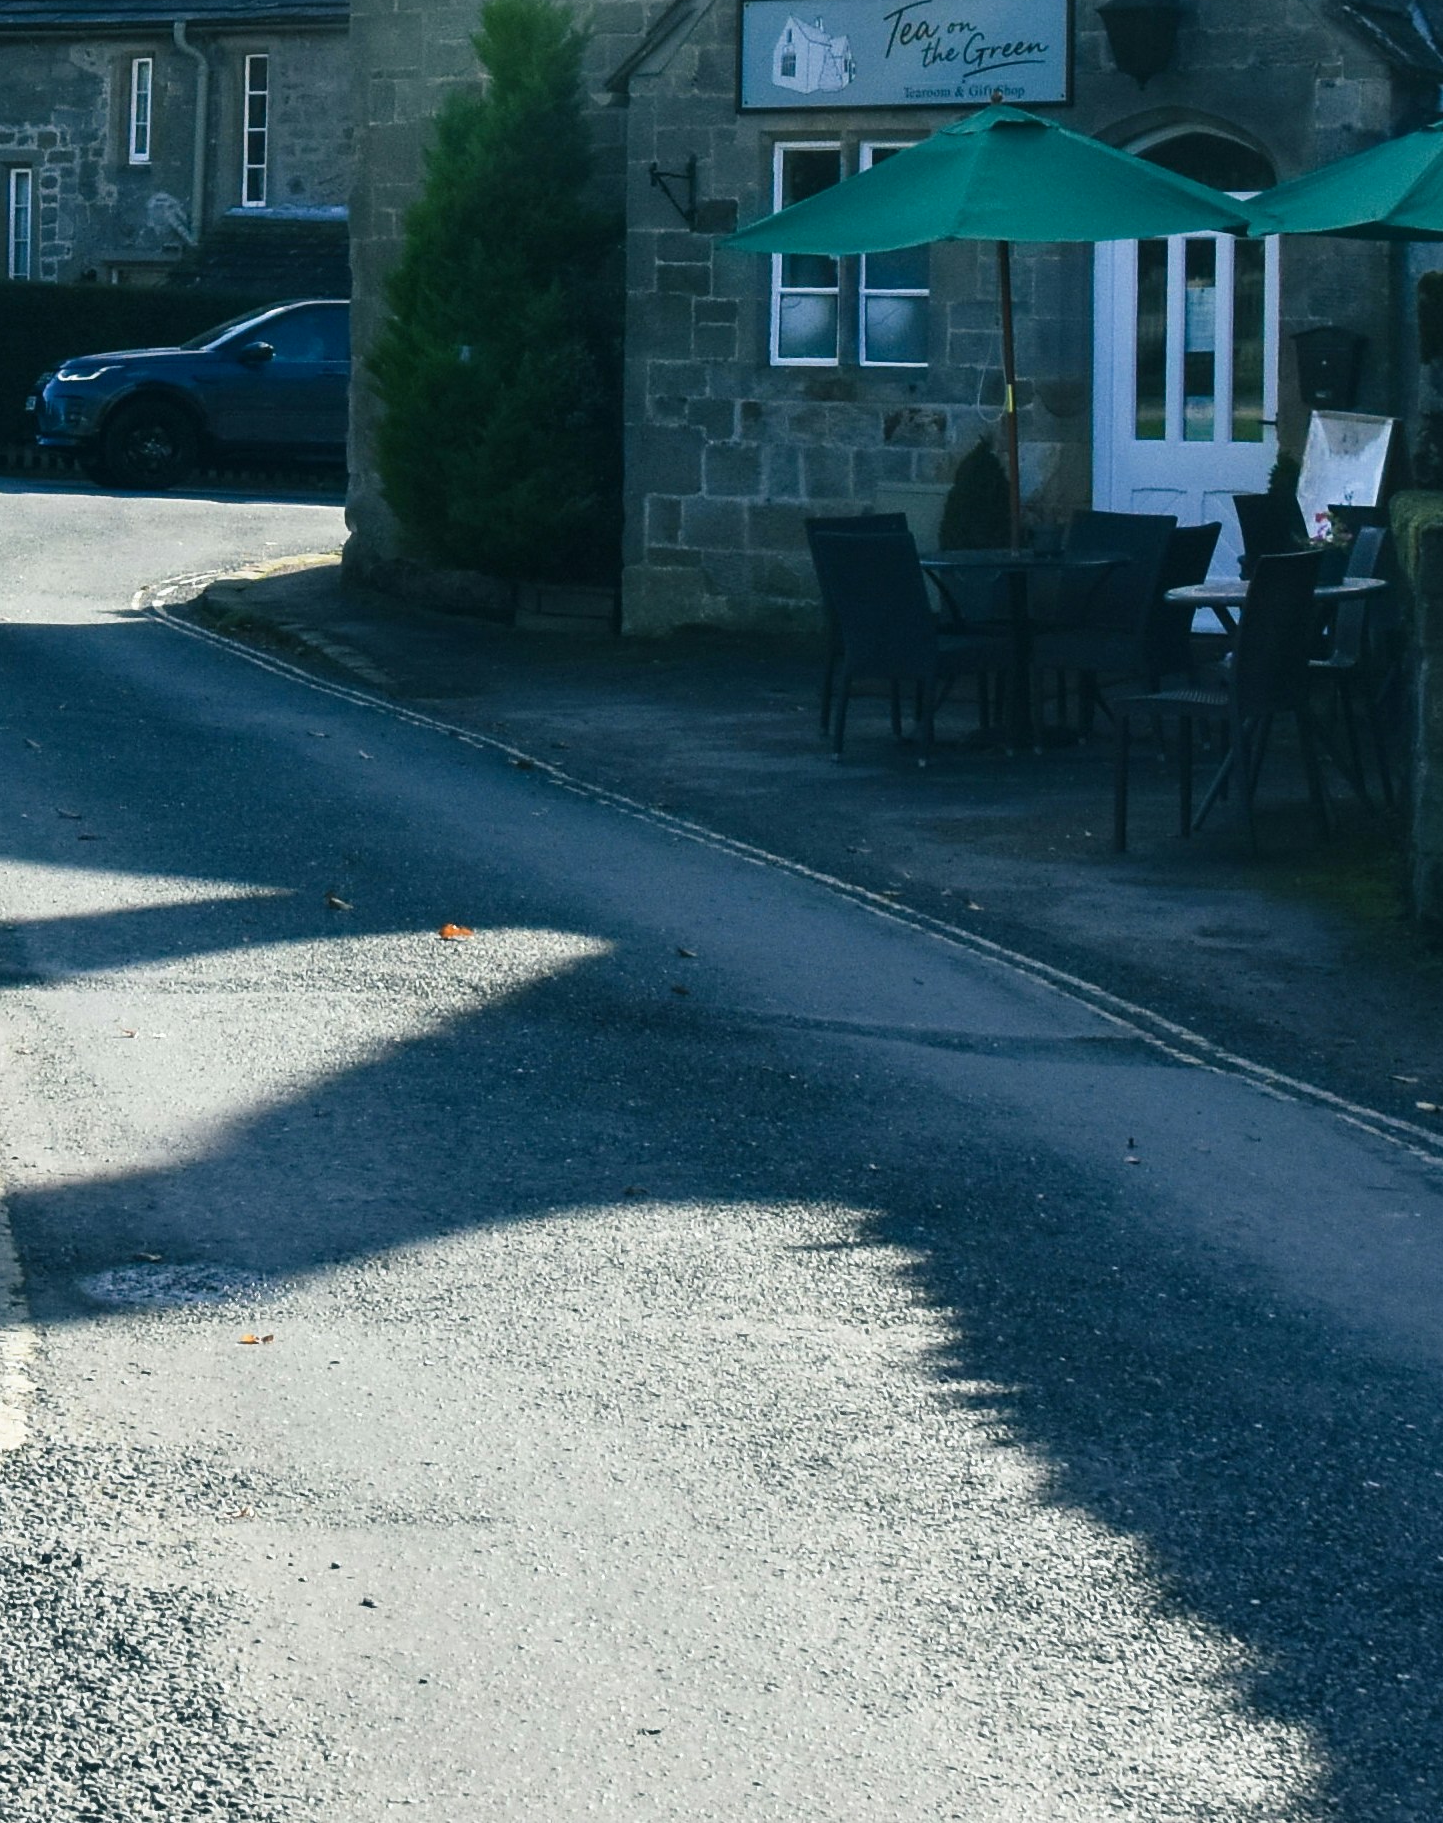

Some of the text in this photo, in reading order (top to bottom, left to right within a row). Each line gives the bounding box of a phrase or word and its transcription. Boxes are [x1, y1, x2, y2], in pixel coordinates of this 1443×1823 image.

[884, 0, 976, 59] Tea on
[921, 32, 1049, 68] the Green
[903, 87, 951, 98] Tearoom
[955, 86, 964, 98] &
